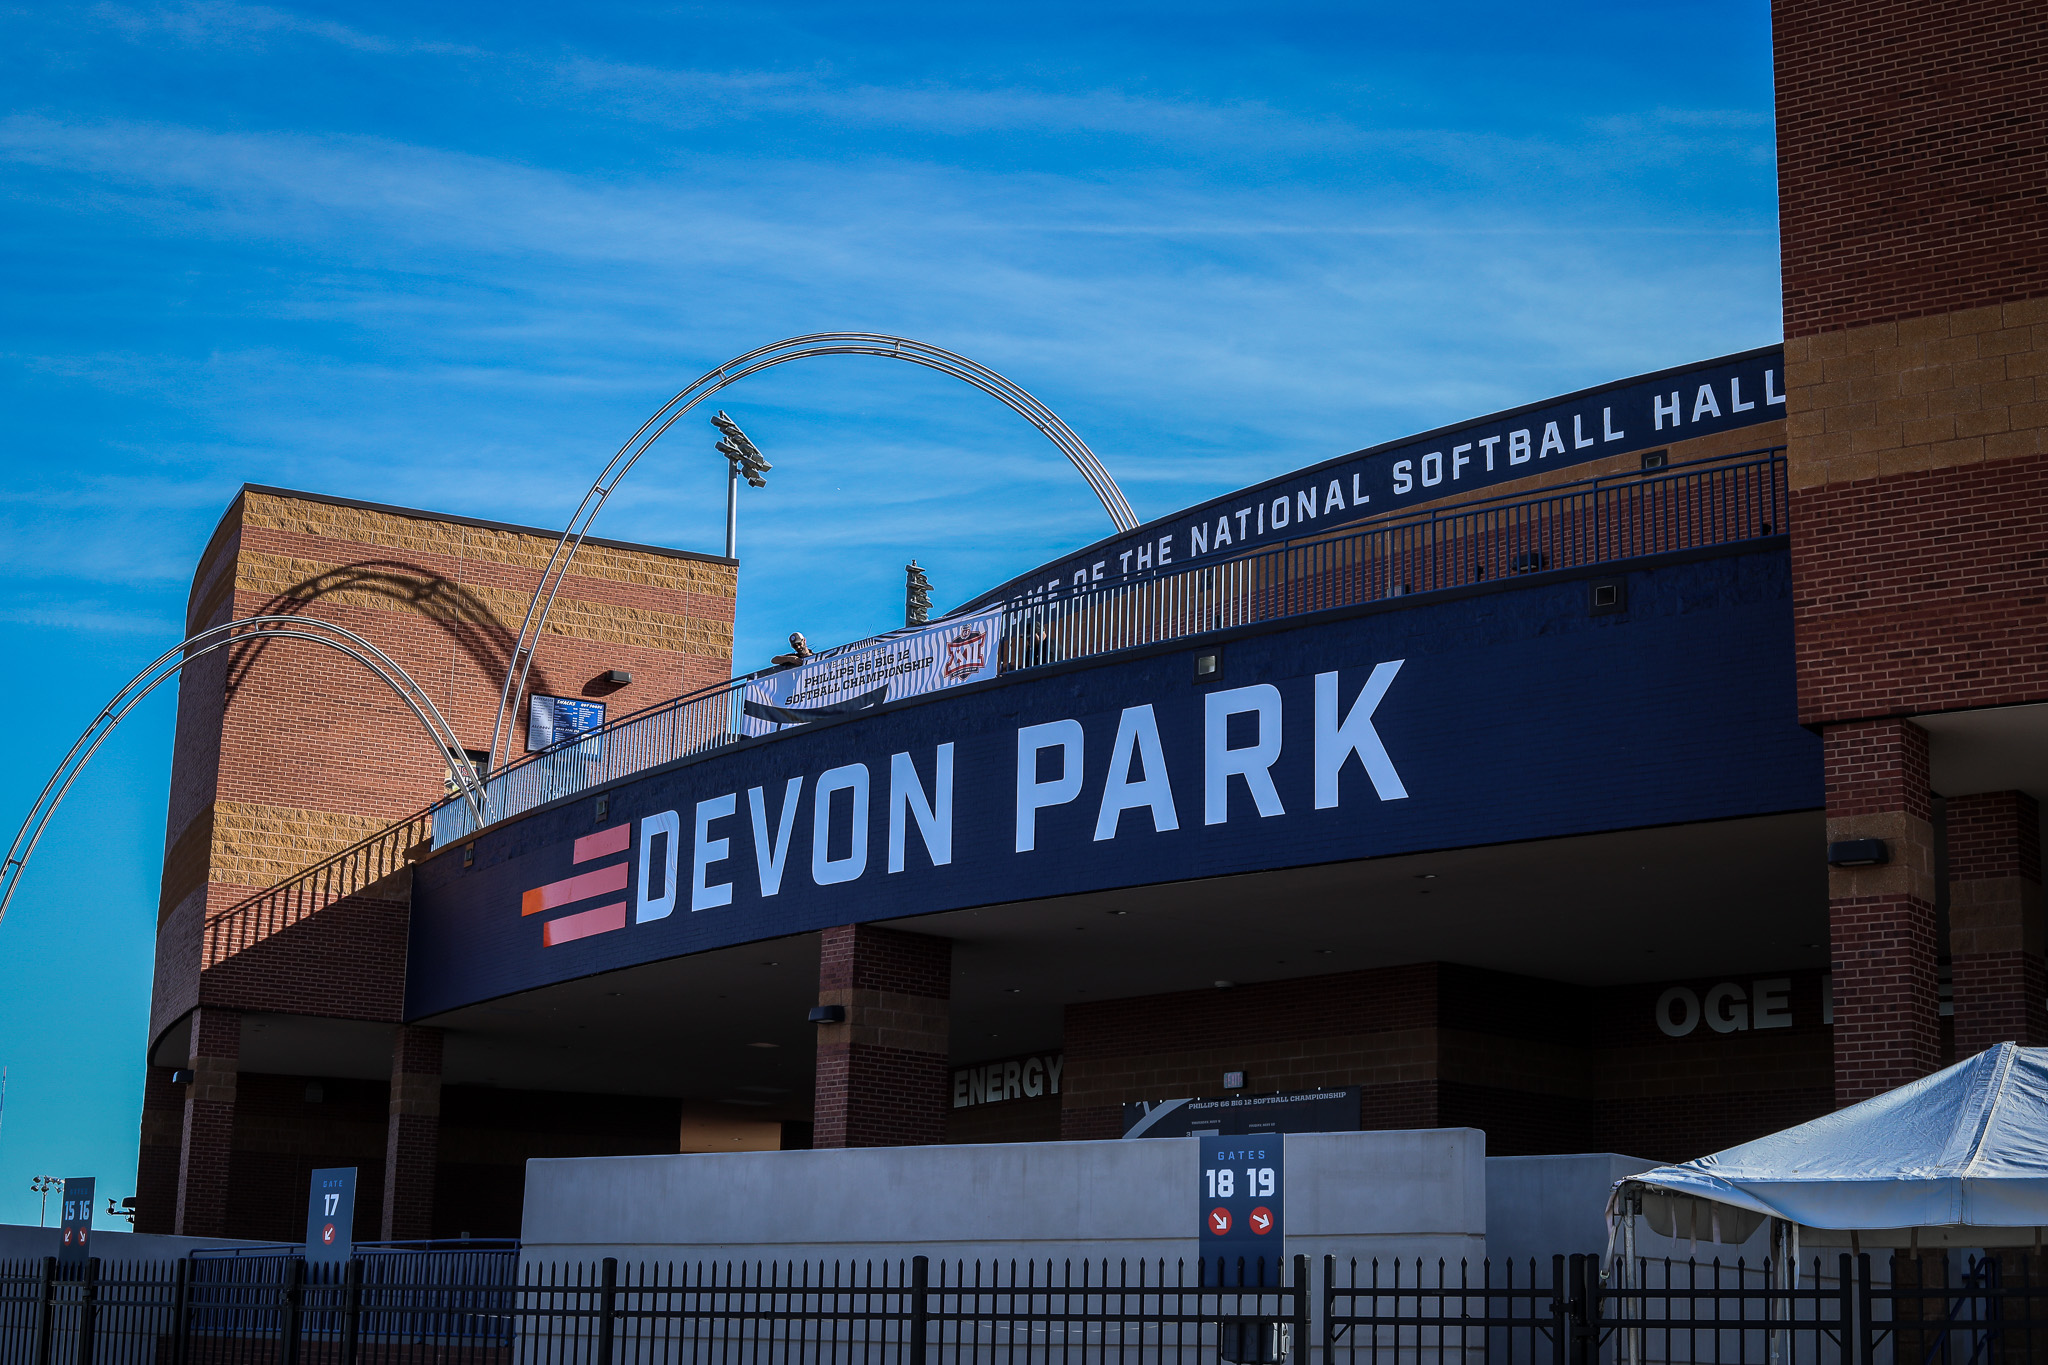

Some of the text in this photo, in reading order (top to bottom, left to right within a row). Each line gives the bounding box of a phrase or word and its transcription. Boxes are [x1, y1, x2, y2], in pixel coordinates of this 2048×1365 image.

[1003, 369, 1786, 628] OME OF THE NATIONAL SOFTBALL HALL
[804, 649, 910, 688] PHILLIPS 66 BIG 12
[825, 646, 887, 670] WELCOME TO THE
[785, 682, 841, 706] SOFTBALL
[842, 656, 934, 691] CHAMPIONSHIP
[636, 659, 1409, 925] DEVON PARK
[1655, 978, 1793, 1037] OGE
[953, 1054, 1064, 1109] ENERGY
[1188, 1101, 1219, 1110] PHILLIPS
[1220, 1100, 1230, 1108] 66
[1231, 1099, 1243, 1107] BIG
[1244, 1098, 1252, 1106] 12
[1253, 1096, 1289, 1105] SOFTBALL
[1290, 1091, 1347, 1103] CHAMPIONSHIP
[1217, 1150, 1265, 1161] GATES
[322, 1179, 343, 1188] GATE
[1206, 1167, 1275, 1198] 18 19
[65, 1200, 90, 1221] 15 16
[324, 1193, 340, 1217] 17
